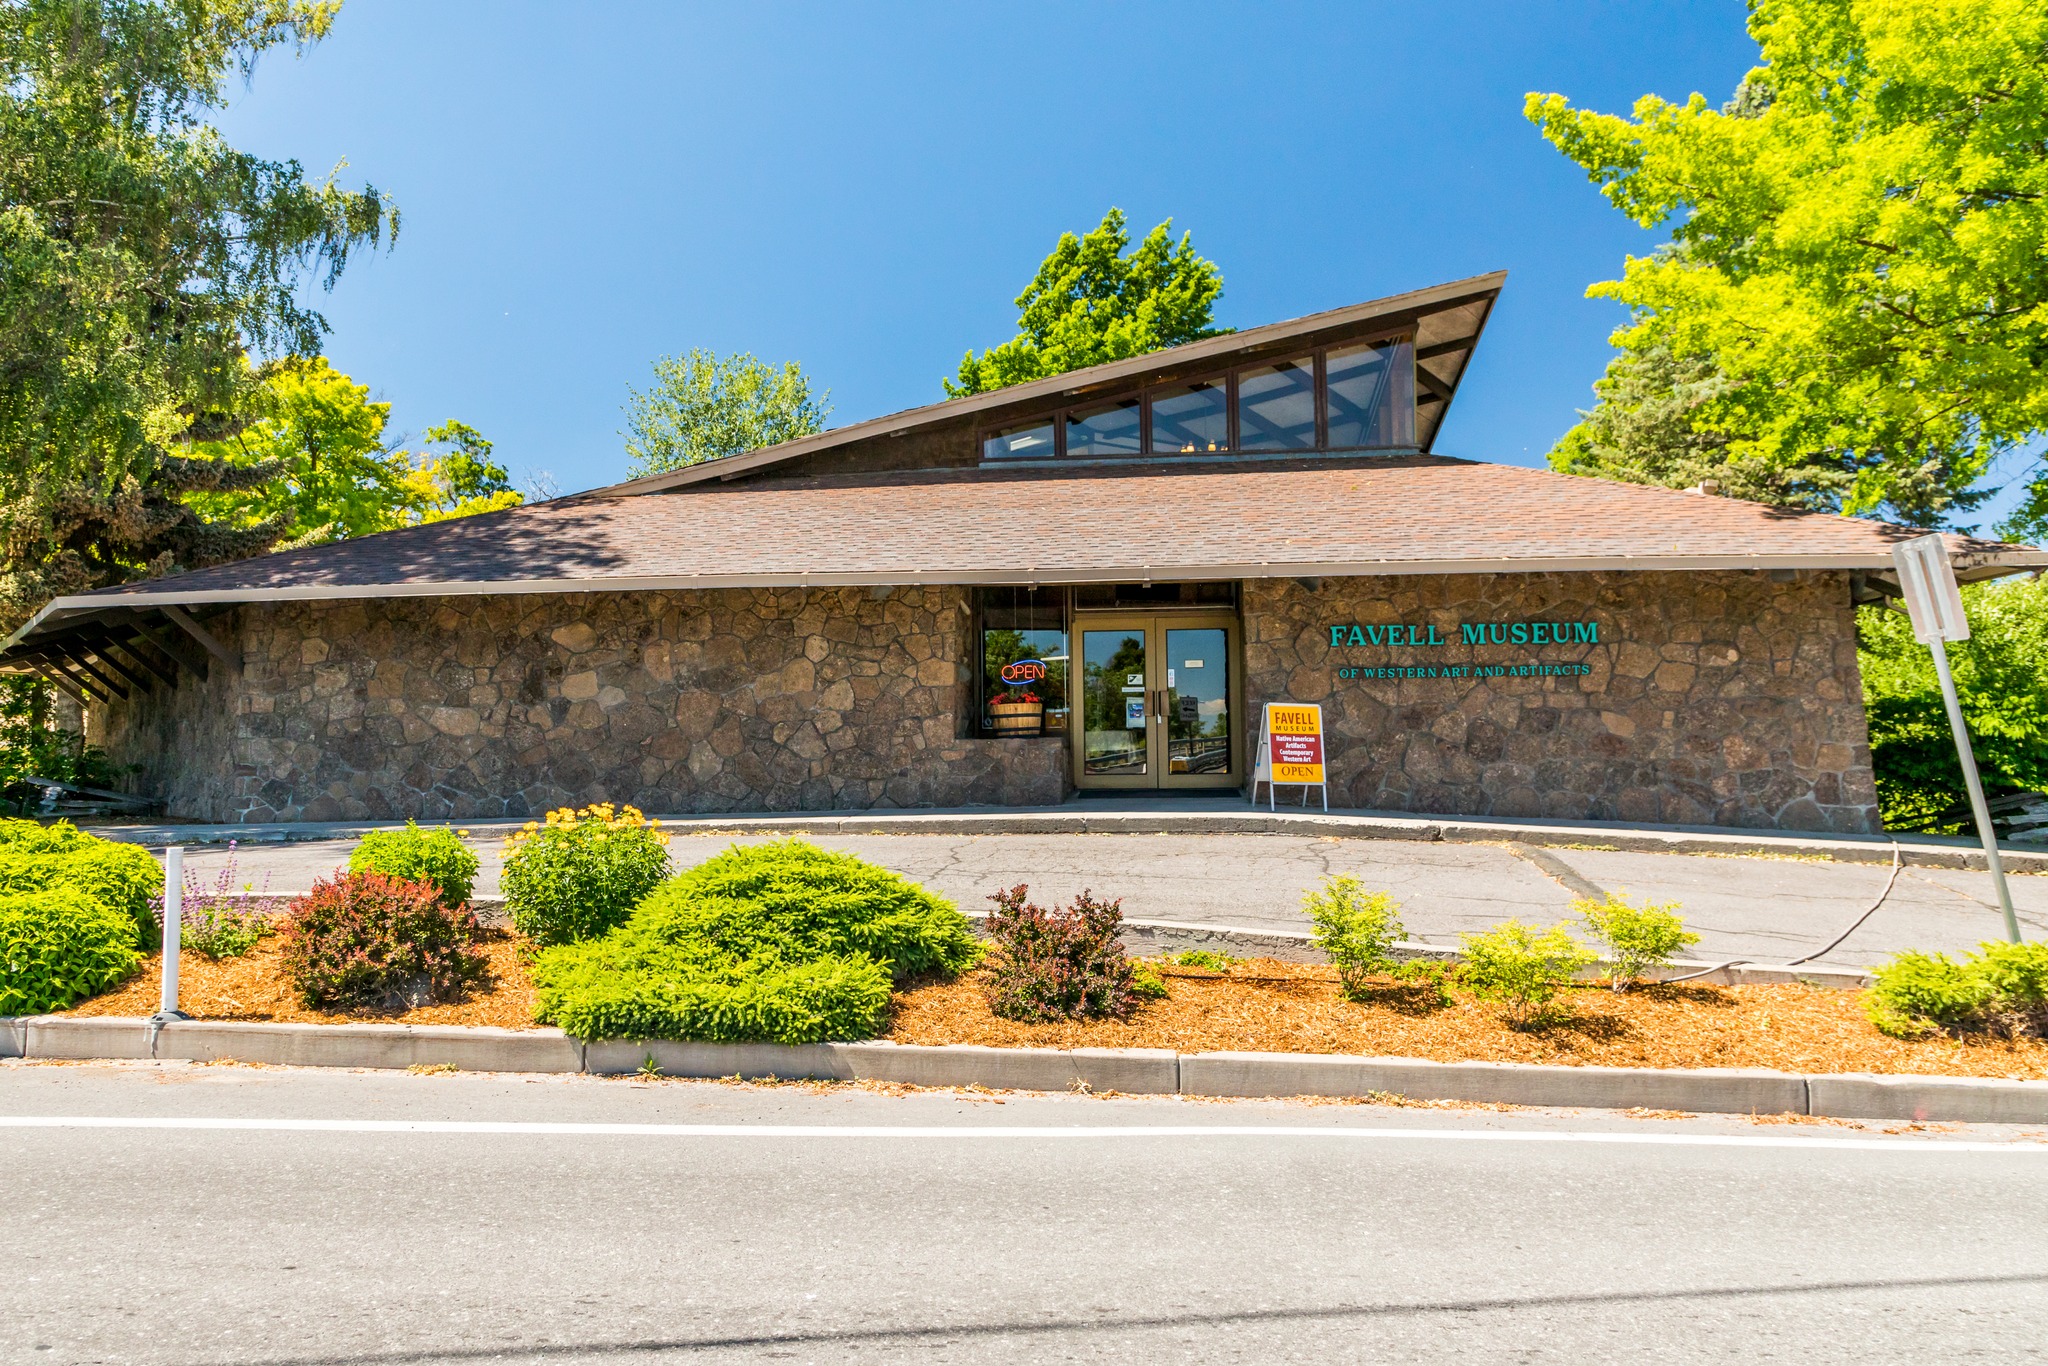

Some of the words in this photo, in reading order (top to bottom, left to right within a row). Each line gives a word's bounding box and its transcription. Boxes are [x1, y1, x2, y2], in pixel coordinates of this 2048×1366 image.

[1330, 624, 1445, 647] FAVELL
[1461, 622, 1599, 645] MUSEUM
[1001, 665, 1045, 679] OPEN
[1339, 668, 1360, 679] OF
[1363, 667, 1437, 678] WESTERN
[1441, 667, 1470, 678] ART
[1473, 665, 1504, 677] AND
[1508, 664, 1591, 677] ARTIFACTS
[1275, 712, 1313, 724] FAVELL
[1282, 766, 1314, 776] OPEN
